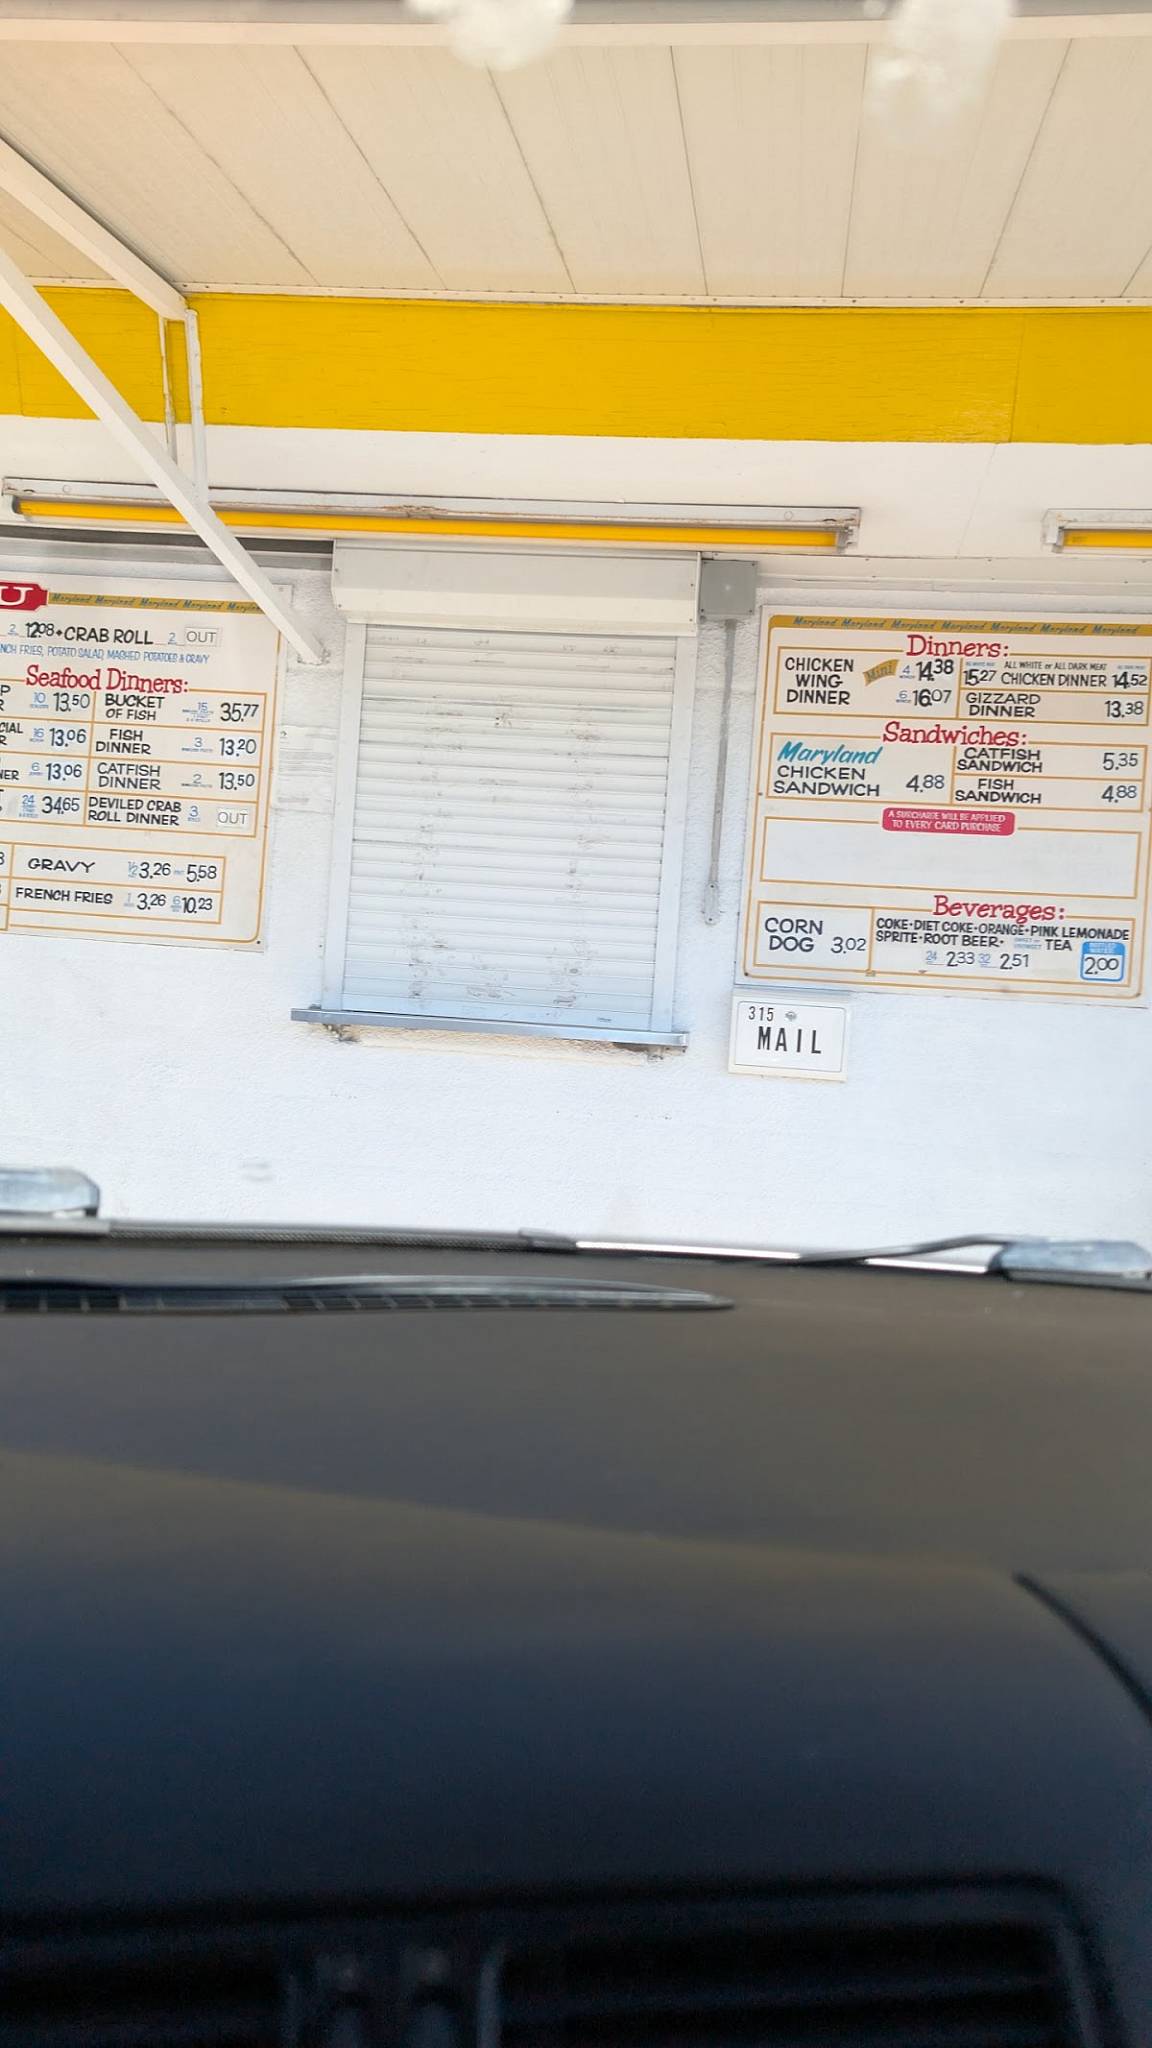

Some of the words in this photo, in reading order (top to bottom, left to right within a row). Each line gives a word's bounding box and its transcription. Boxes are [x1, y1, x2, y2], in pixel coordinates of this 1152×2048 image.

[64, 626, 110, 642] CRAB
[113, 628, 154, 645] ROLL
[186, 630, 217, 643] OUT
[48, 645, 76, 657] POTATO
[906, 634, 1009, 658] Dinners:
[784, 657, 854, 672] CHICKEN
[916, 658, 954, 681] 14.38
[1004, 661, 1018, 669] ALL
[1019, 661, 1043, 670] WHITE
[1054, 662, 1068, 671] ALL
[1068, 663, 1089, 671] DARK
[1090, 663, 1107, 671] MEAT
[26, 664, 102, 690] Seafood
[106, 667, 189, 693] Dinners:
[796, 674, 843, 688] WING
[1001, 672, 1055, 686] CHICKEN
[1058, 674, 1107, 687] DINNER
[53, 692, 90, 712] 13.50
[105, 693, 165, 709] BUCKET
[786, 689, 851, 705] DINNER
[965, 692, 1041, 705] GIZZARD
[105, 709, 123, 719] OF
[126, 710, 157, 721] FISH
[220, 702, 259, 722] 35.77
[968, 704, 1035, 718] DINNER
[1105, 700, 1144, 718] 13.38
[49, 728, 87, 747] 13.06
[109, 729, 143, 742] FISH
[882, 721, 1028, 747] Sandwiches:
[95, 741, 151, 755] DINNER
[219, 738, 257, 757] 13.20
[777, 741, 884, 765] Maryland
[964, 747, 1040, 761] CATFISH
[97, 762, 161, 777] CATFISH
[956, 759, 1043, 773] SANDWICH
[1103, 752, 1138, 771] 5.35
[46, 763, 82, 781] 13.06
[777, 765, 866, 781] CHICKEN
[98, 776, 161, 790] DINNER
[218, 772, 255, 791] 13.50
[773, 780, 880, 797] SANDWICH
[906, 774, 945, 793] 4.88
[977, 778, 1014, 790] FISH
[955, 790, 1042, 804] SANDWICH
[1101, 785, 1138, 803] 4.88
[41, 796, 81, 815] 34.65
[88, 797, 144, 811] DEVILED
[146, 800, 182, 813] CRAB
[87, 810, 121, 823] ROLL
[126, 812, 180, 826] DINNER
[217, 812, 248, 825] OUT
[892, 820, 903, 828] TO
[905, 820, 931, 830] EVERY
[934, 821, 959, 831] CARD
[961, 822, 1001, 832] PURCHASE
[941, 812, 958, 820] WILL
[971, 813, 1006, 823] APPLIED
[27, 858, 95, 873] GRAVY
[139, 862, 171, 879] 3.26
[186, 864, 217, 883] 5.58
[15, 887, 70, 902] FRENCH
[74, 891, 114, 905] FRIES
[137, 893, 167, 910] 3.26
[182, 897, 213, 914] 10.23
[933, 895, 1066, 924] Beverages:
[765, 917, 823, 935] CORN
[1062, 927, 1130, 941] LEMONADE
[769, 935, 814, 952] DOG
[830, 936, 866, 954] 3.02
[1045, 939, 1072, 951] TEA
[1000, 953, 1029, 970] 2.51
[1084, 956, 1120, 975] 2.00
[748, 1006, 774, 1021] 315
[757, 1025, 822, 1054] MAIL
